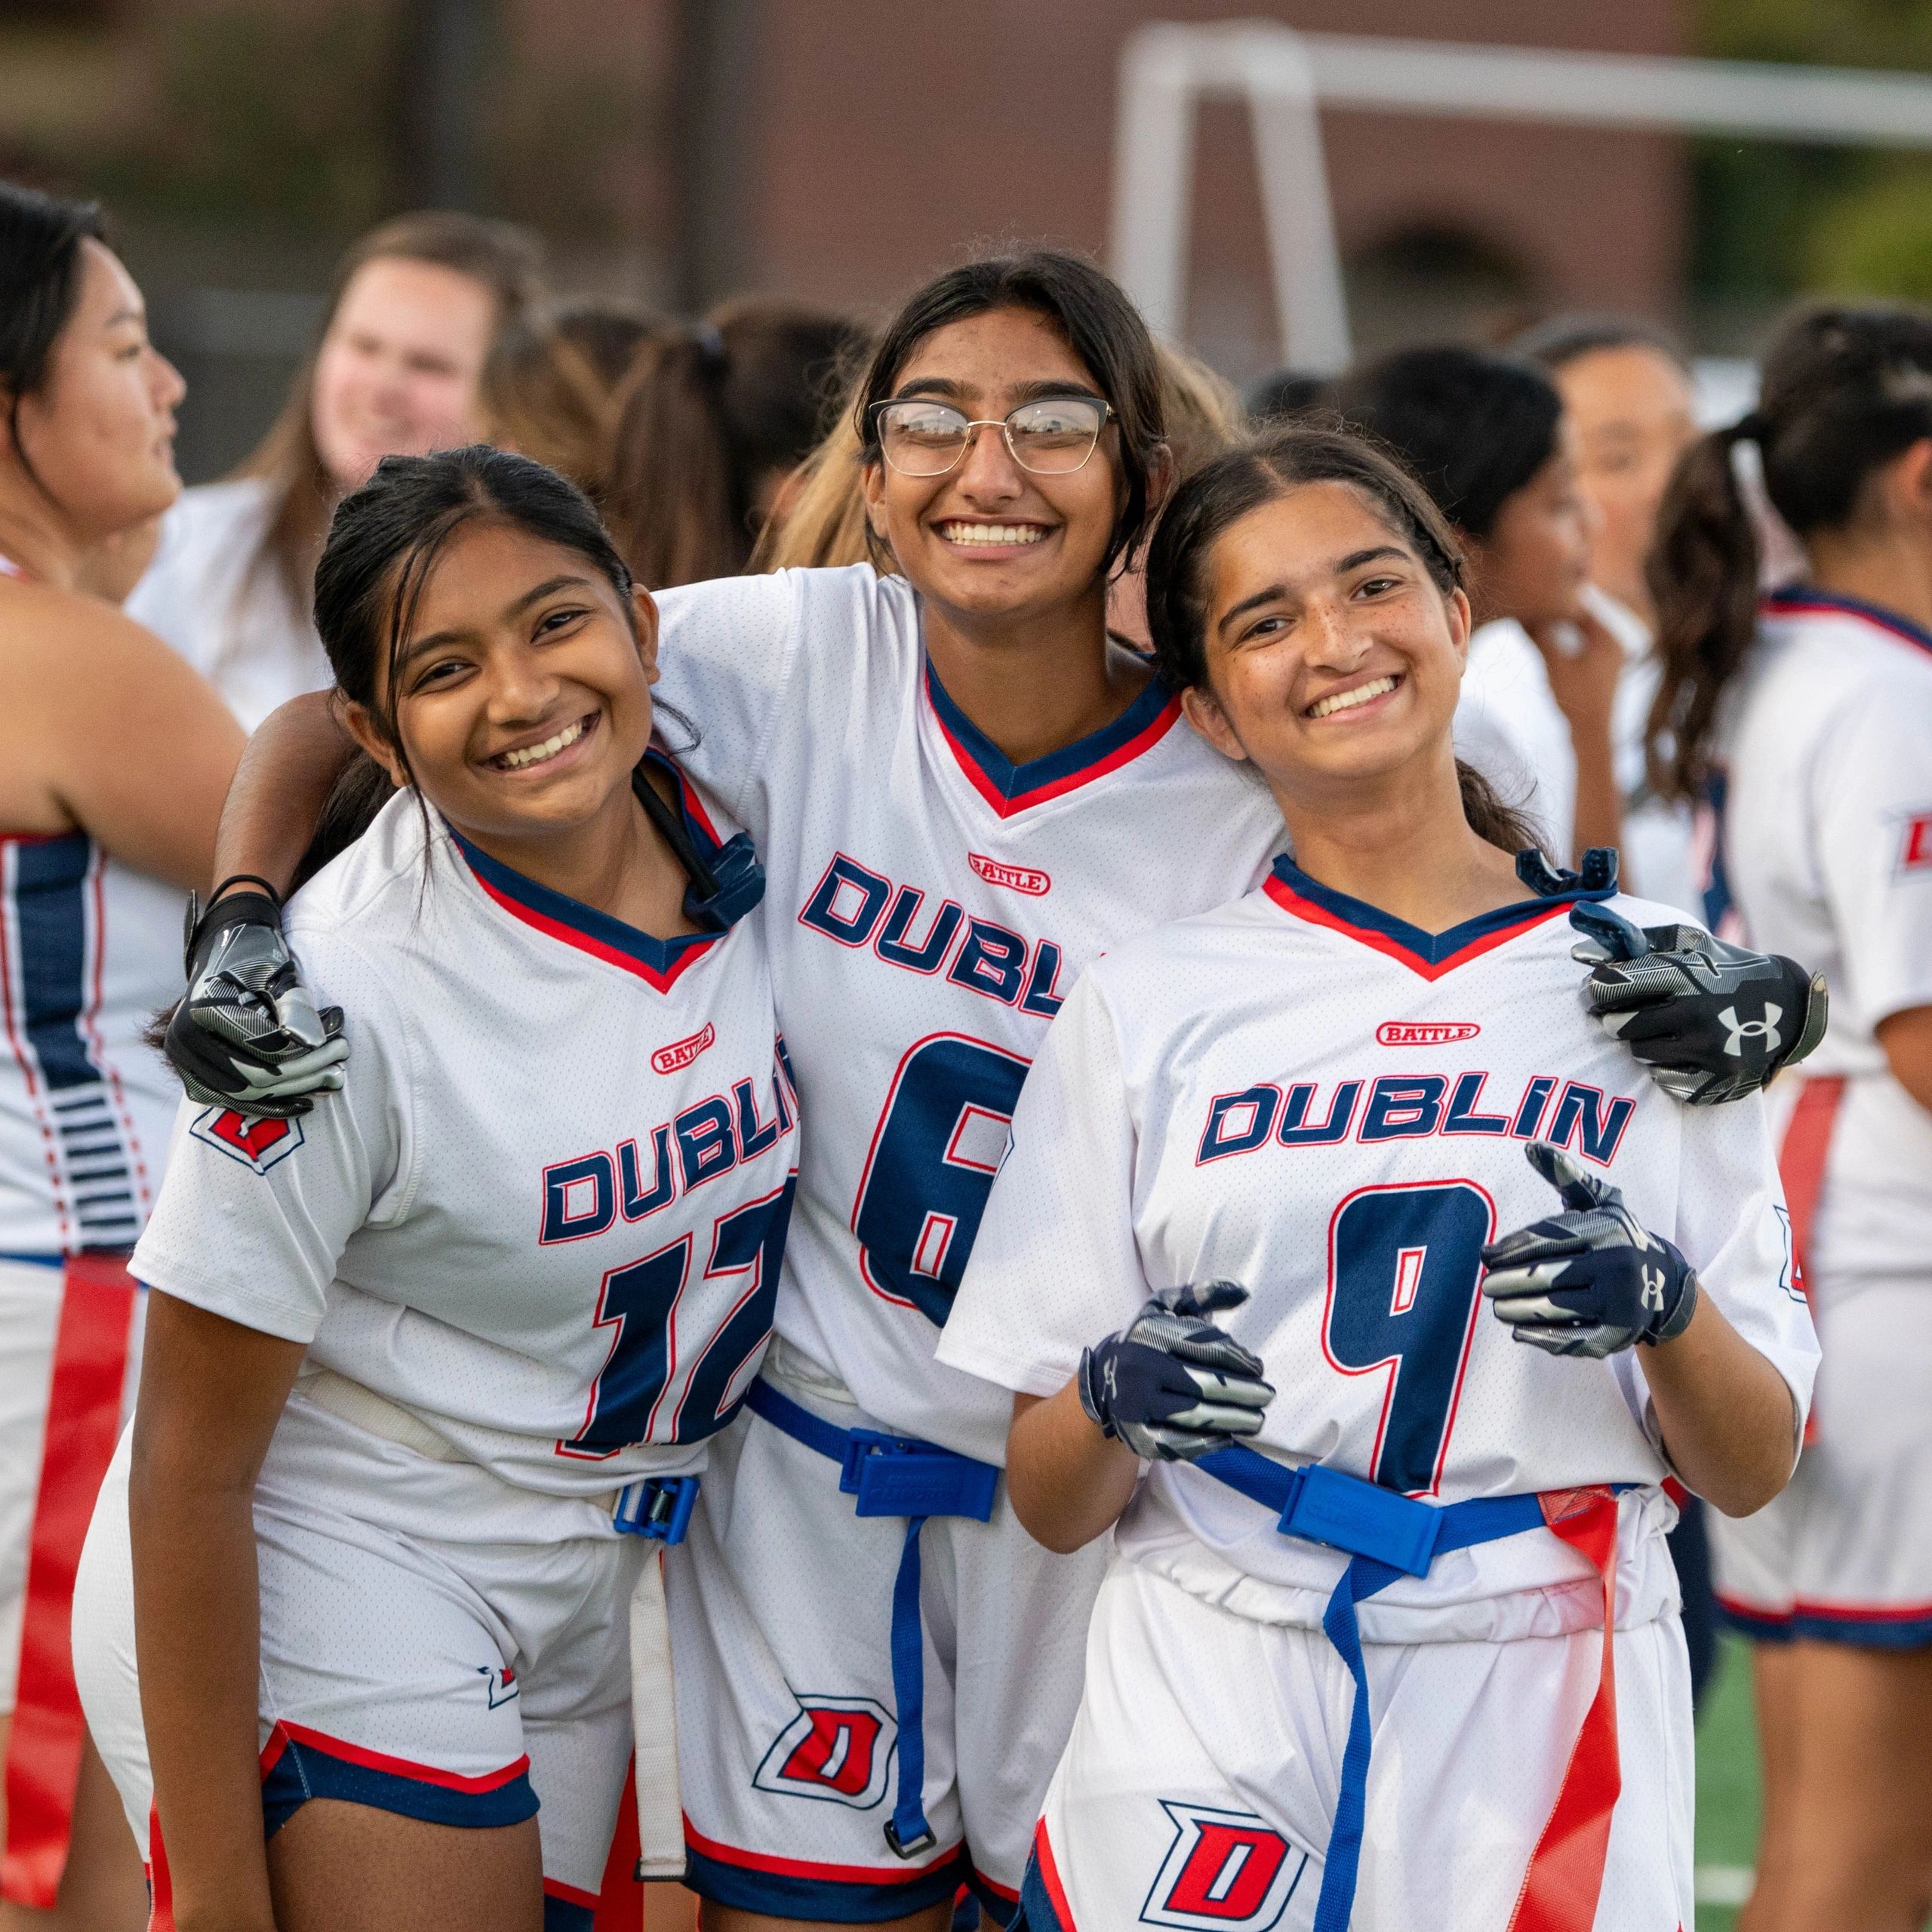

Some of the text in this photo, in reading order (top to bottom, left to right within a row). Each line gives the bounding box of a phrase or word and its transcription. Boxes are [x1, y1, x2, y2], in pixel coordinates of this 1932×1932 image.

[539, 1033, 800, 1245] DUBLI
[1195, 1072, 1636, 1167] DUBLIN
[1386, 1027, 1472, 1041] BATTLE
[555, 1168, 798, 1462] 12
[1321, 1178, 1497, 1498] 9
